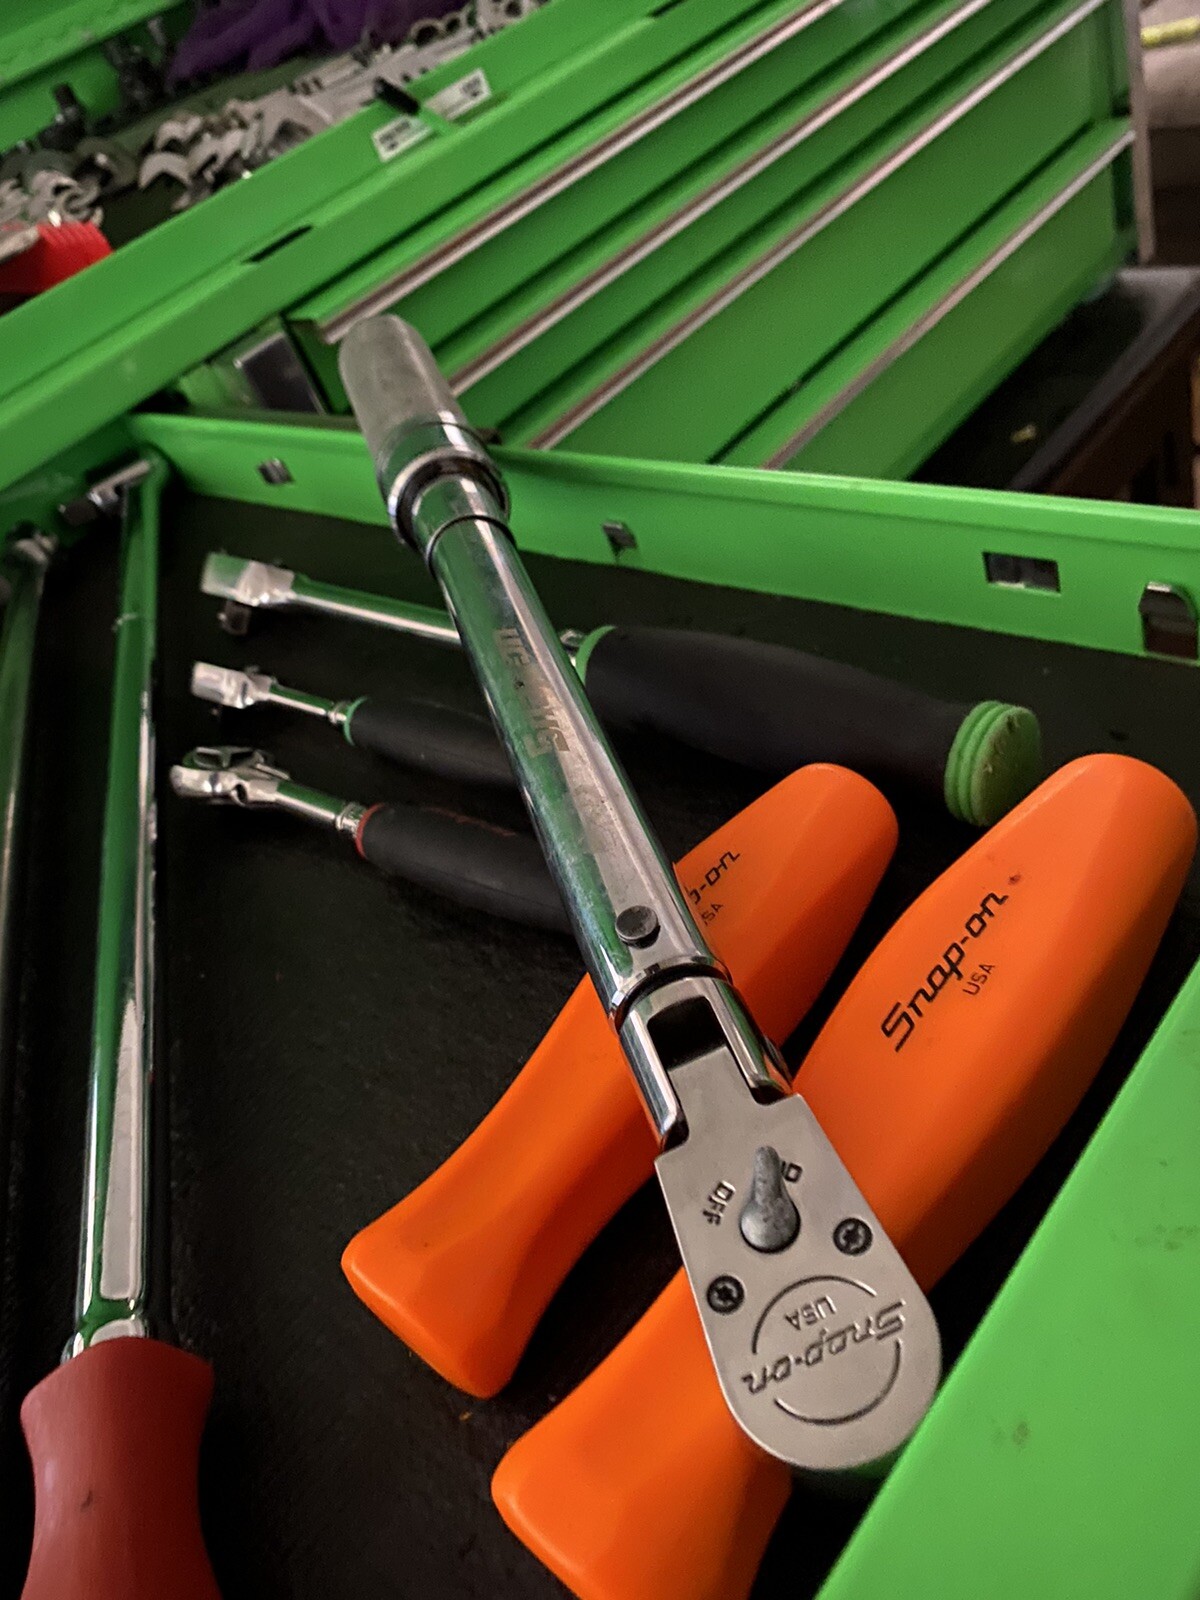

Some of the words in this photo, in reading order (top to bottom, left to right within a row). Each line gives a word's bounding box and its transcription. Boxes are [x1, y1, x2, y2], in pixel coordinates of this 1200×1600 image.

[702, 902, 724, 926] SA
[881, 890, 1009, 1053] Snap-on
[962, 962, 996, 997] USA
[701, 1180, 736, 1226] OFF
[784, 1295, 838, 1332] USA
[741, 1299, 907, 1395] Snap-on
